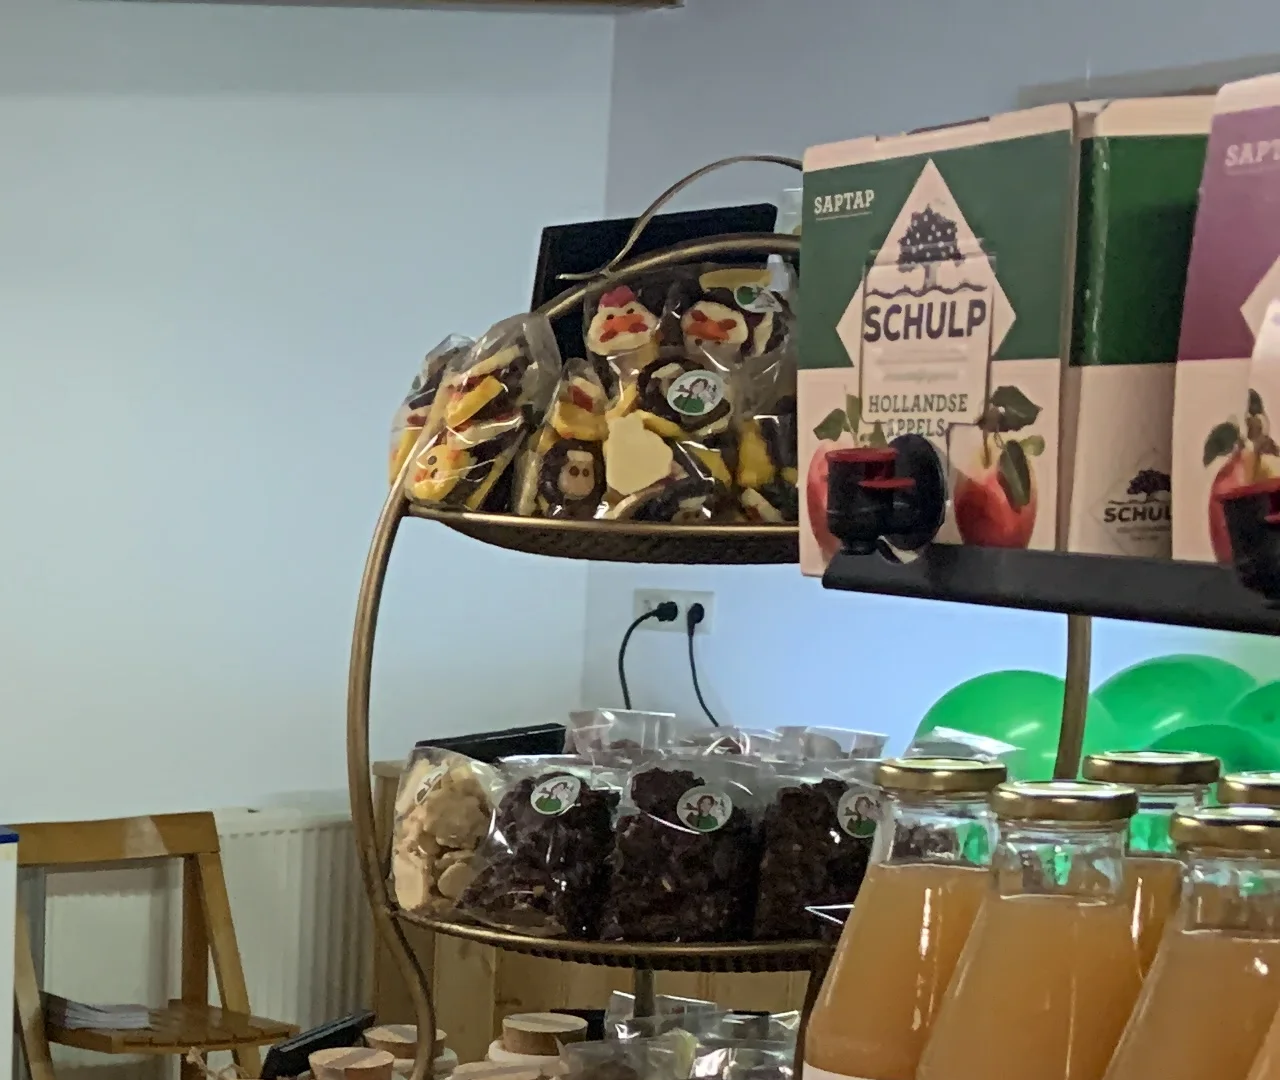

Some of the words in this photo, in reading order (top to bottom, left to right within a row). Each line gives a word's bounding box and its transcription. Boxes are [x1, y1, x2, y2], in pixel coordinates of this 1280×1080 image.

[813, 188, 875, 214] SAPTAP
[863, 298, 987, 343] SCHULP
[868, 393, 969, 414] HOLLANDSE
